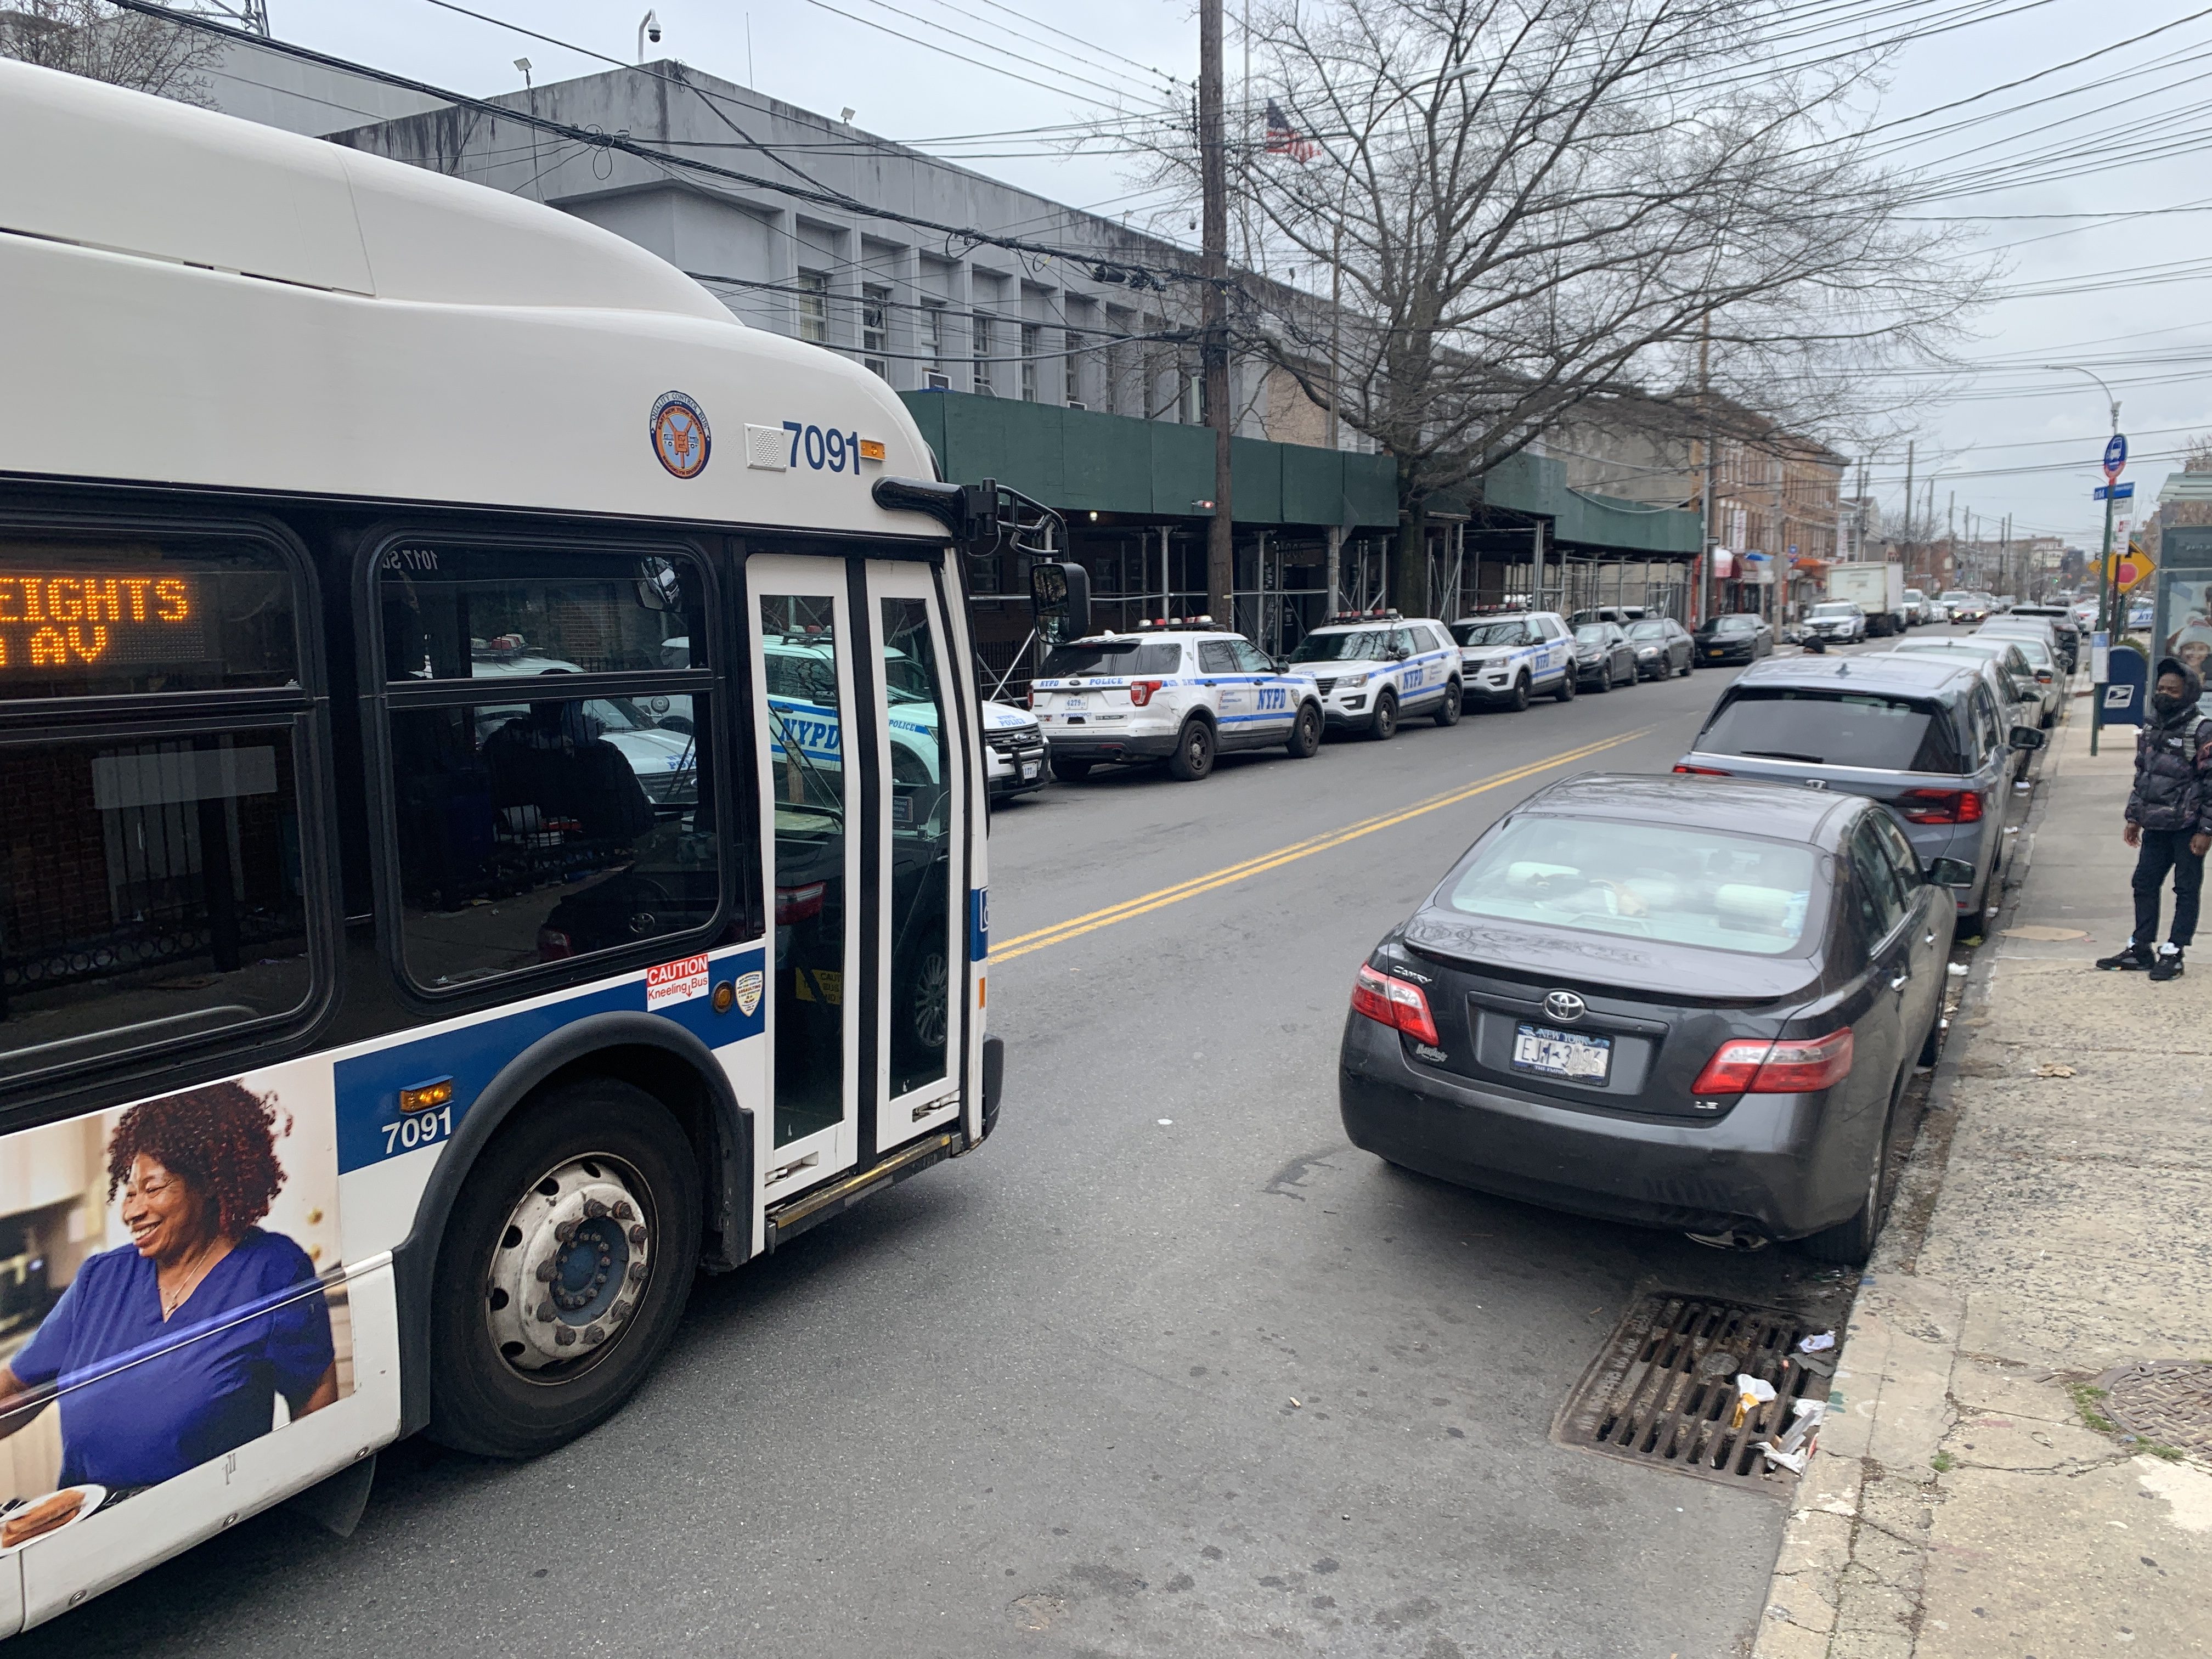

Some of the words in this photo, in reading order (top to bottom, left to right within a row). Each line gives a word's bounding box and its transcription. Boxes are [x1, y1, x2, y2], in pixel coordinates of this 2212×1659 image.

[651, 394, 670, 421] QUALITY
[672, 393, 697, 412] CONTROL
[698, 411, 708, 430] BUS
[782, 420, 860, 475] 7091
[30, 625, 108, 665] AV
[1089, 678, 1124, 686] POLICE
[1403, 668, 1424, 690] NYPD
[1066, 698, 1081, 707] 4279
[1257, 688, 1286, 710] NYPD
[889, 719, 916, 731] POLICE
[998, 718, 1026, 726] POLICE
[779, 718, 841, 750] NYPD
[648, 956, 708, 985] CAUTION
[647, 983, 687, 1001] Kneeling
[691, 977, 708, 989] Bus
[1538, 1028, 1561, 1041] NEW
[1563, 1032, 1589, 1045] YORK
[1694, 1101, 1719, 1109] LE
[381, 1105, 452, 1155] 7091
